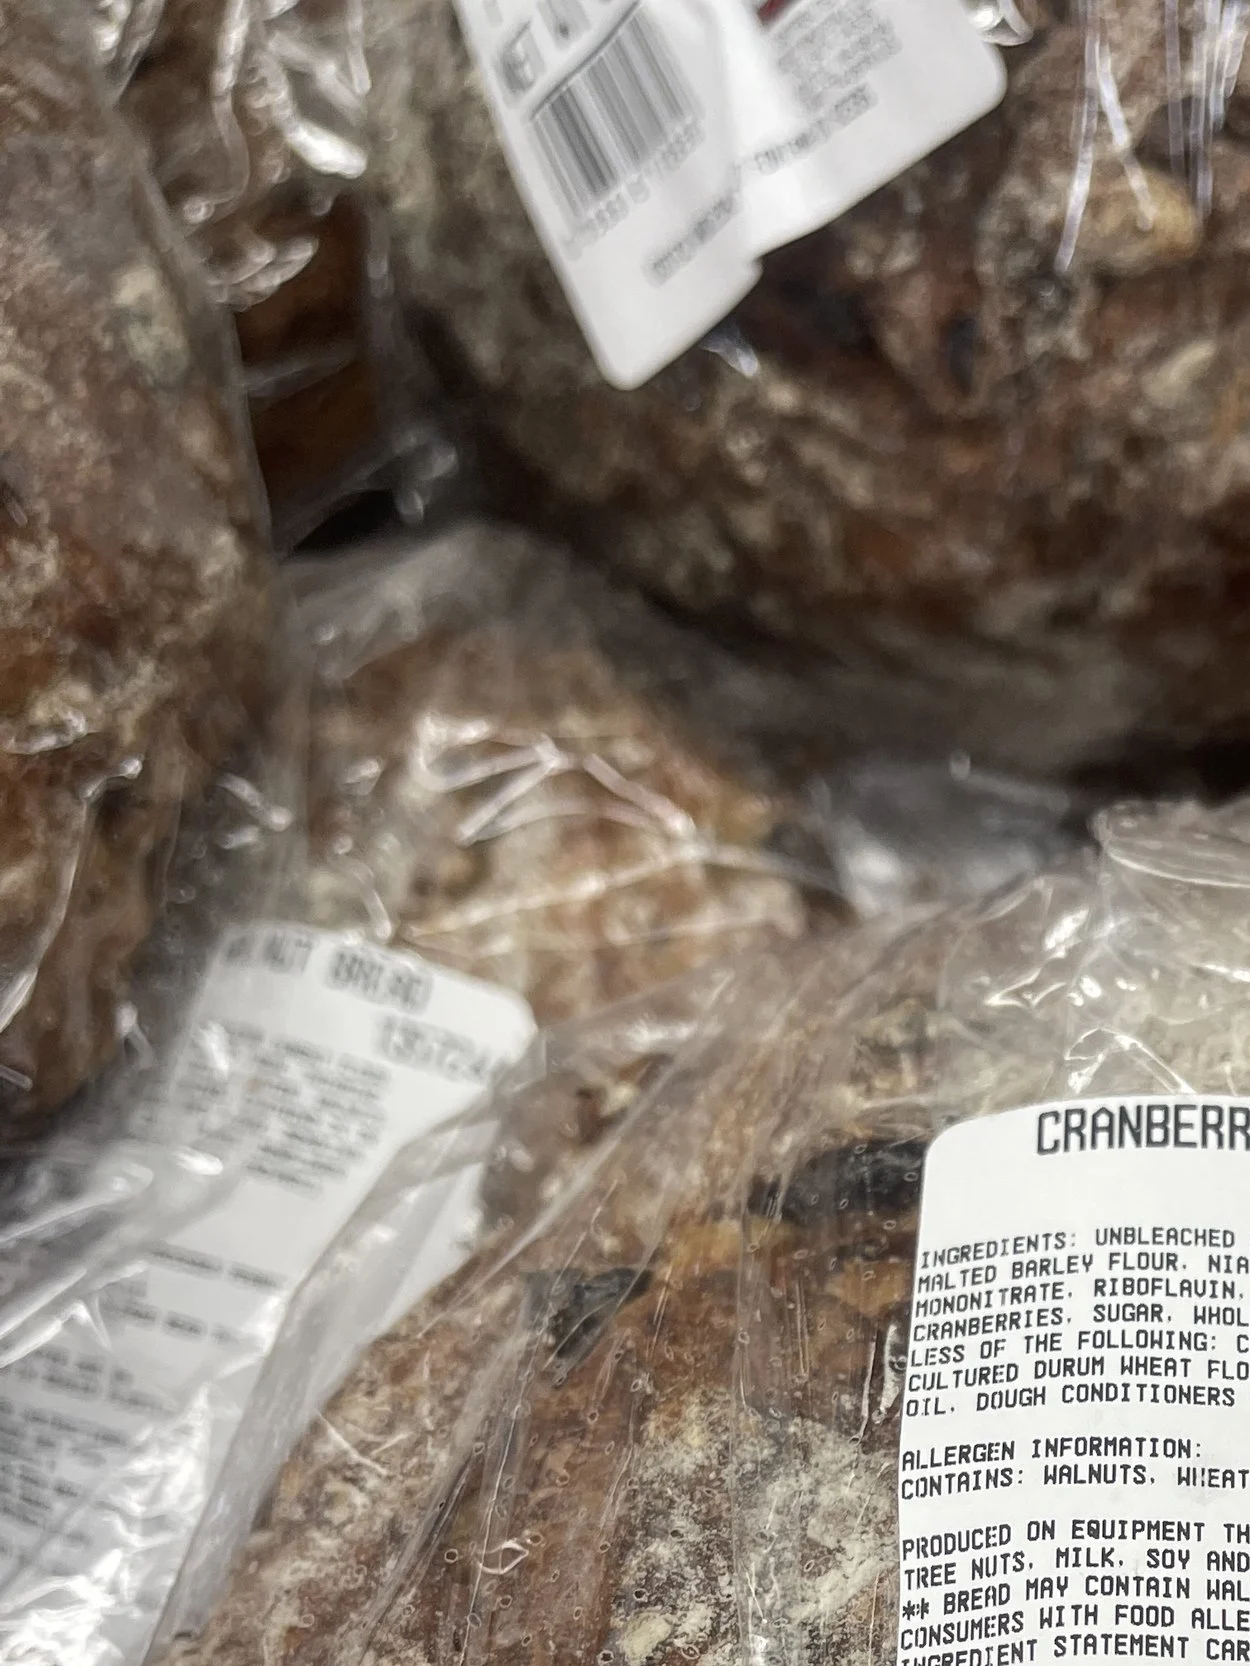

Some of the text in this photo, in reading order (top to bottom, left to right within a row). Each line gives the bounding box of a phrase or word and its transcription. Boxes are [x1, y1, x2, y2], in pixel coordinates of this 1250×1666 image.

[922, 1232, 1076, 1268] INGREDIENTS:
[1095, 1226, 1236, 1249] UNBLEACHED
[920, 1264, 997, 1293] MALTED
[1011, 1253, 1094, 1280] BARLEY
[913, 1343, 965, 1368] LESS
[979, 1338, 1007, 1360] OF
[1023, 1332, 1063, 1355] THE
[1077, 1328, 1216, 1352] FOLLOWING:
[910, 1362, 1020, 1393] CULTURED
[1033, 1355, 1105, 1380] DURUM
[1120, 1354, 1192, 1378] WHEAT
[975, 1381, 1235, 1412] DOUGH CONDITIONERS
[904, 1435, 1201, 1471] ALLERGEN INFORMATION:
[901, 1467, 1024, 1500] CONTAINS:
[902, 1523, 1012, 1561] PRODUCED
[1026, 1519, 1056, 1542] ON
[1071, 1518, 1206, 1543] EQUIPMENT
[904, 1561, 957, 1591] TREE
[1146, 1547, 1191, 1570] SOY
[1206, 1550, 1250, 1574] AND
[943, 1582, 1011, 1616] BREAD
[1025, 1575, 1069, 1602] MAY
[1085, 1574, 1191, 1600] CONTAIN
[900, 1610, 1024, 1651] CONSUMERS
[1039, 1603, 1099, 1630] WITH
[1114, 1603, 1175, 1628] FOOD
[1053, 1632, 1190, 1659] STATEMENT
